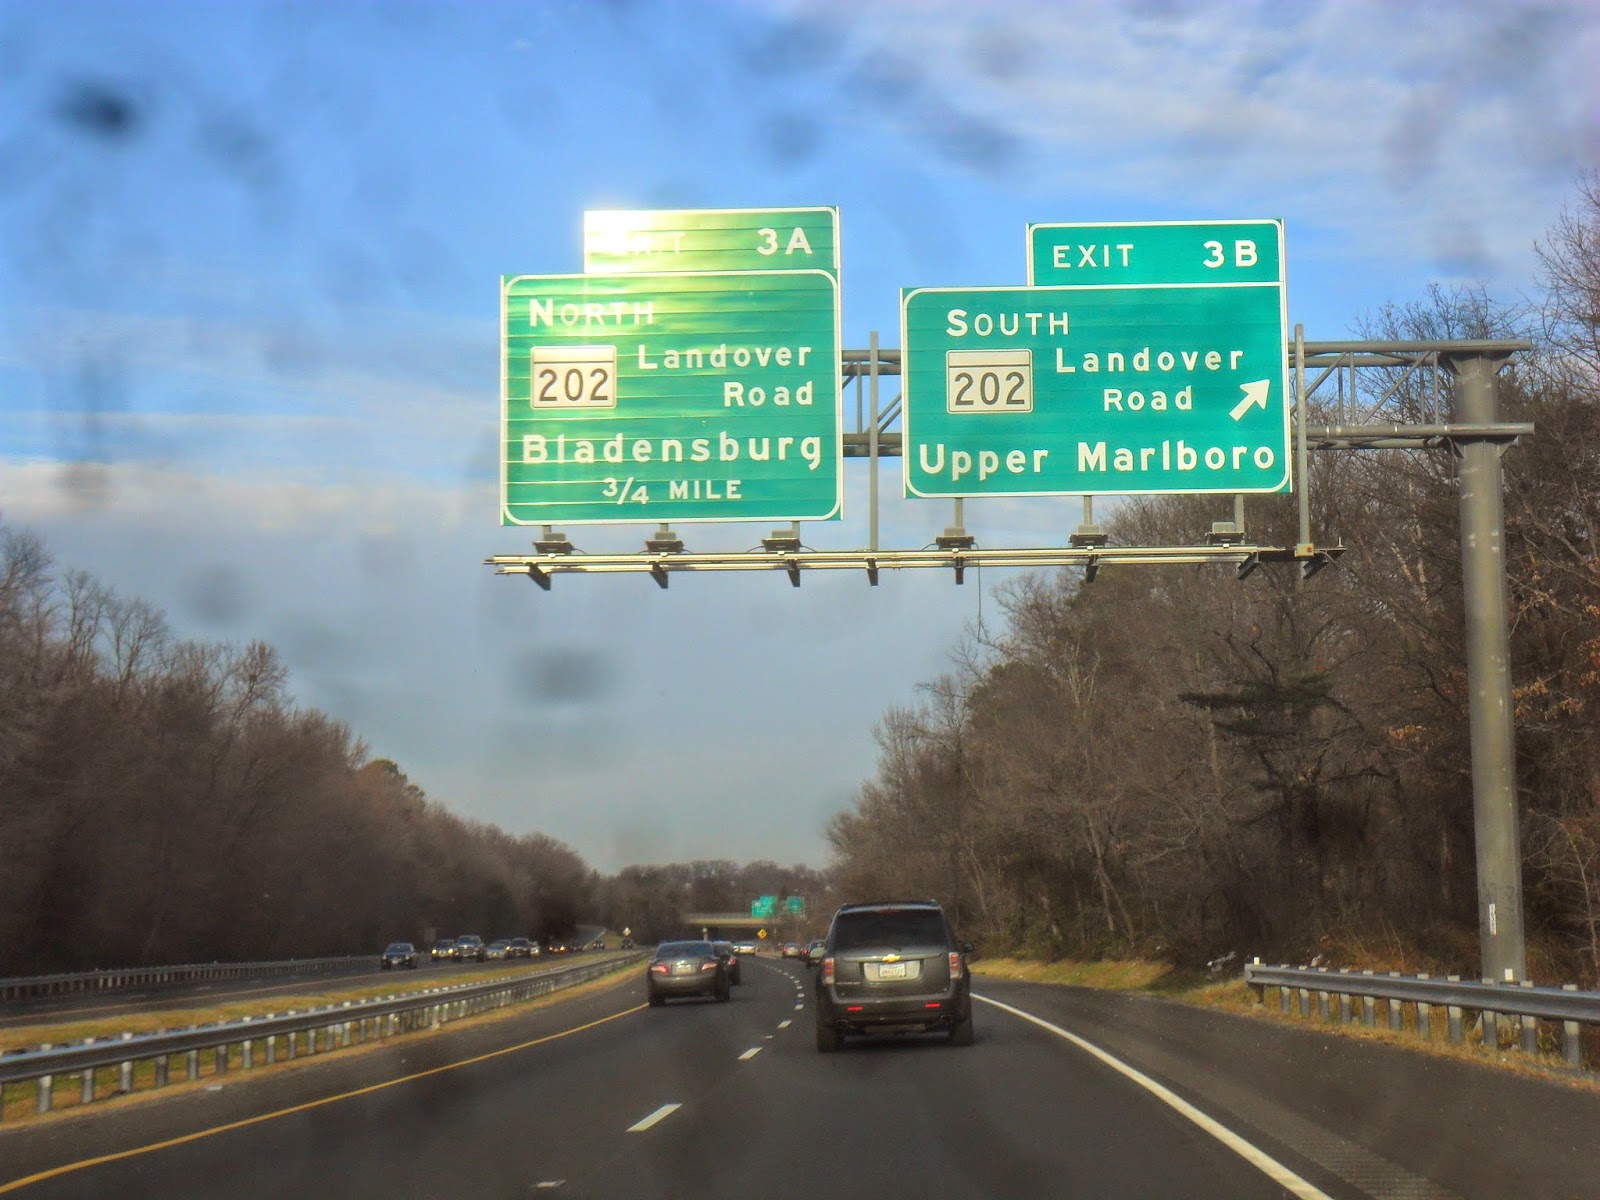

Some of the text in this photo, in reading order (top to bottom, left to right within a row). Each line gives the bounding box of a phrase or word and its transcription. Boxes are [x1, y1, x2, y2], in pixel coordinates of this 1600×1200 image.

[756, 227, 813, 255] 3A
[1052, 240, 1258, 269] EXIT 3B
[529, 298, 654, 327] NORTH
[945, 308, 1070, 337] SOUTH
[637, 343, 812, 370] Landover
[1055, 347, 1244, 373] Landover
[539, 368, 609, 403] 202
[723, 380, 813, 407] Road
[953, 371, 1026, 406] 202
[1103, 385, 1192, 412] Road
[522, 431, 822, 471] Bladensburg
[919, 440, 1275, 481] Upper Marlboro
[602, 477, 742, 505] 3/4 MILE
